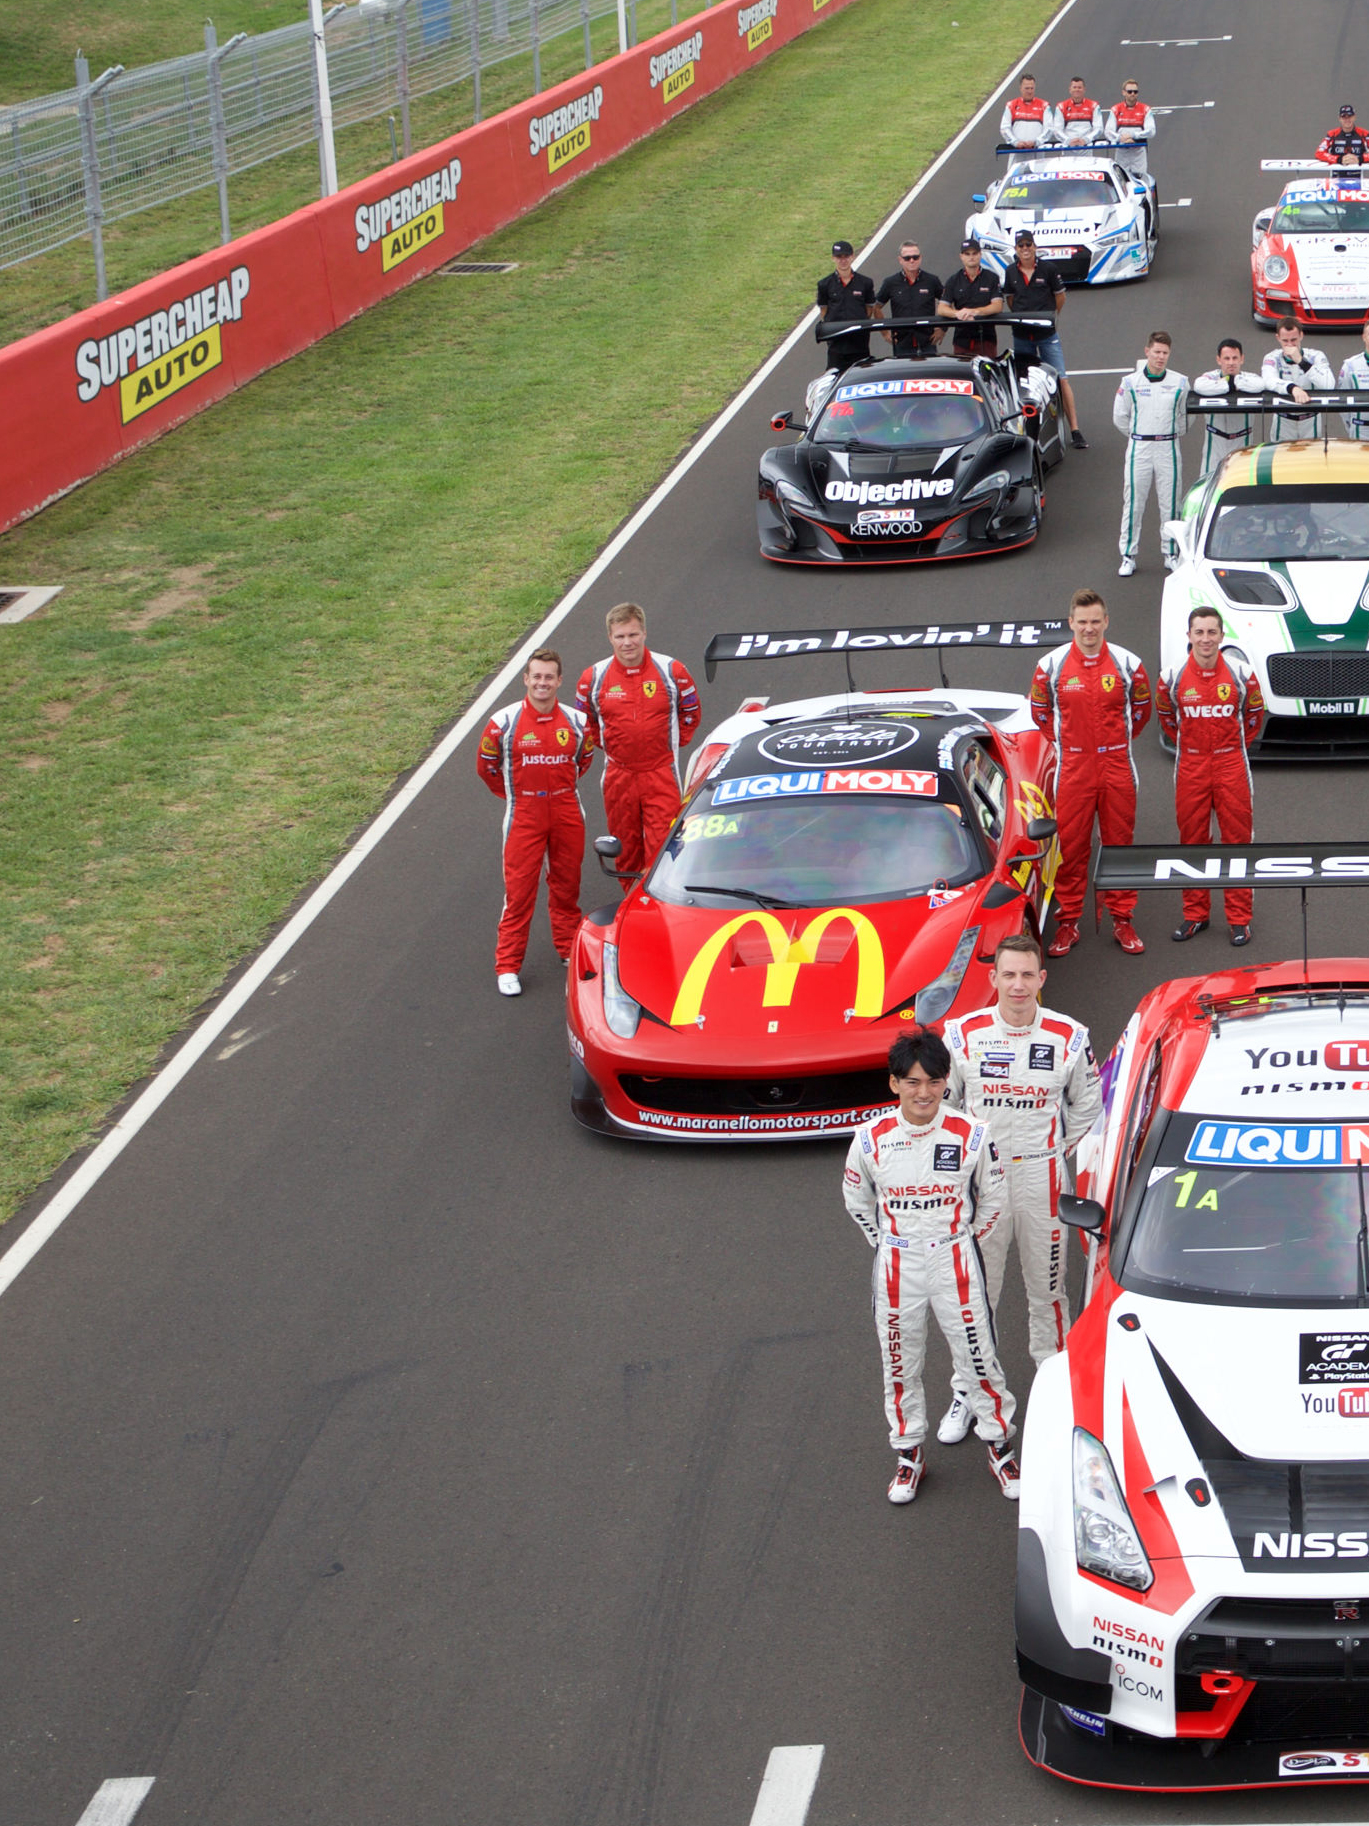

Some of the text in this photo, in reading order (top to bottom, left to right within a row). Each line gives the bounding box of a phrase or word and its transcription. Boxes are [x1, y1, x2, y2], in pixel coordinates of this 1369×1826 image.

[751, 22, 769, 43] AUTO
[650, 30, 703, 88] SUPERCHEAP
[667, 68, 691, 96] AUTO
[529, 85, 603, 156] SUPERCHEAP
[554, 130, 585, 163] AUTO
[1013, 172, 1103, 184] LIQUI MOLY
[355, 157, 462, 253] SUPERCHEAP
[1287, 191, 1337, 204] LIQUI
[390, 214, 438, 259] AUTO
[1050, 248, 1070, 257] STIX
[75, 266, 250, 402] SUPERCHEAP
[134, 340, 210, 405] AUTO
[840, 380, 972, 401] LIQUI MOLY
[825, 478, 955, 505] Objective
[850, 521, 922, 536] KENWOOD
[883, 510, 913, 521] STIX
[735, 634, 821, 656] i'm
[831, 625, 991, 649] lovin'
[999, 623, 1040, 645] it
[1183, 705, 1235, 717] IVECO
[1309, 702, 1354, 714] Mobil 1
[777, 741, 826, 750] YOUR
[522, 753, 569, 766] justcuts
[719, 771, 936, 802] LIQUI MOLY
[983, 1084, 1049, 1096] NISSAN
[984, 1097, 1046, 1109] nismo
[638, 1105, 898, 1131] www.maranellomotorsport.com
[1197, 1124, 1337, 1162] LIQUI
[888, 1185, 955, 1197] NISSAN
[890, 1197, 956, 1210] nismo
[1050, 1229, 1060, 1292] nismo
[888, 1313, 904, 1378] NISSAN
[961, 1309, 986, 1377] nismo
[1093, 1616, 1165, 1651] NISSAN
[1093, 1635, 1163, 1668] nismo
